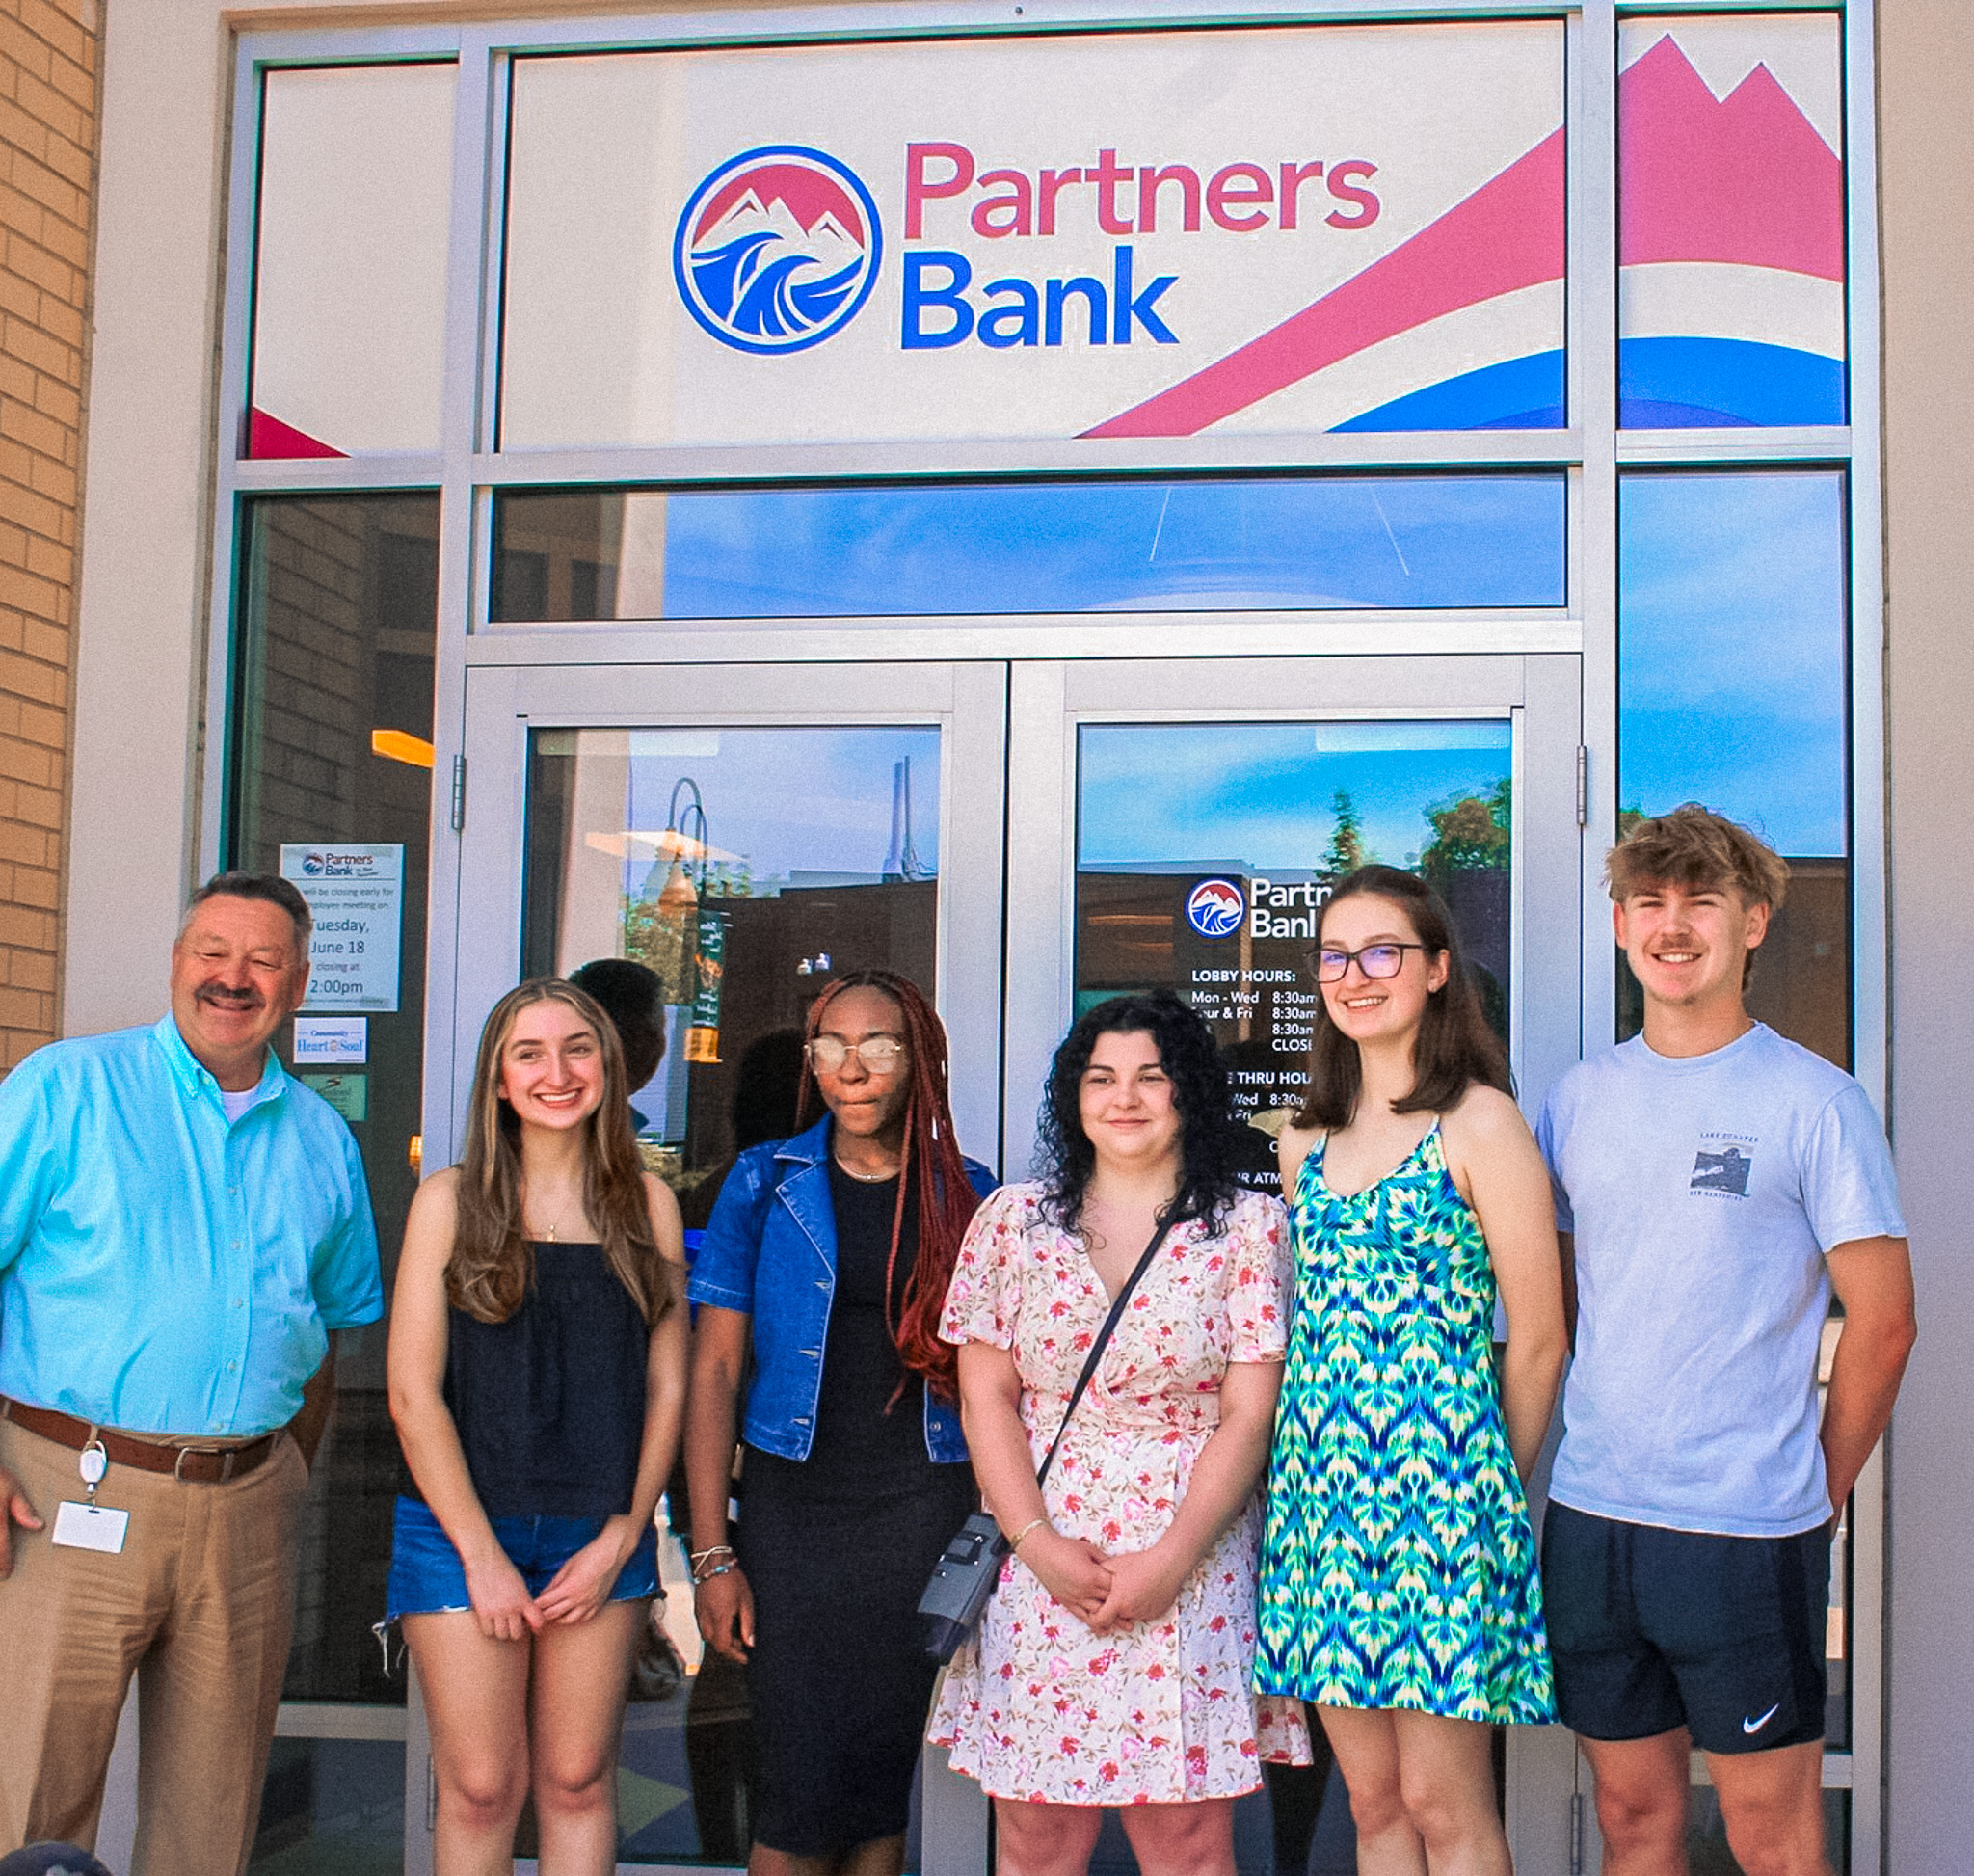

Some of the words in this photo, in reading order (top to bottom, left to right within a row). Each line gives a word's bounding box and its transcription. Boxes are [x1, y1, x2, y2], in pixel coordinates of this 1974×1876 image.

[905, 142, 1380, 240] Partners
[900, 246, 1180, 350] Bank
[326, 853, 373, 865] Partners
[325, 865, 353, 876] Bank
[331, 888, 358, 898] closing
[360, 888, 380, 898] early
[1250, 878, 1332, 907] Partn
[342, 902, 376, 911] meeting
[1250, 909, 1316, 938] Ban
[311, 941, 344, 954] June
[348, 940, 365, 954] 18
[316, 962, 348, 973] closing
[1191, 970, 1239, 982] LOBBY
[1241, 970, 1296, 982] HOURS:
[310, 979, 363, 996] 2:00pm
[1191, 991, 1220, 1004] Mon
[1230, 991, 1260, 1004] Wed
[1223, 1007, 1234, 1019] &
[1237, 1007, 1253, 1019] Fri
[297, 1039, 328, 1052] Heart
[339, 1039, 362, 1052] Soul
[1237, 1072, 1275, 1085] THRU
[1279, 1072, 1312, 1085] HOU
[1269, 1093, 1303, 1106] 8:30a
